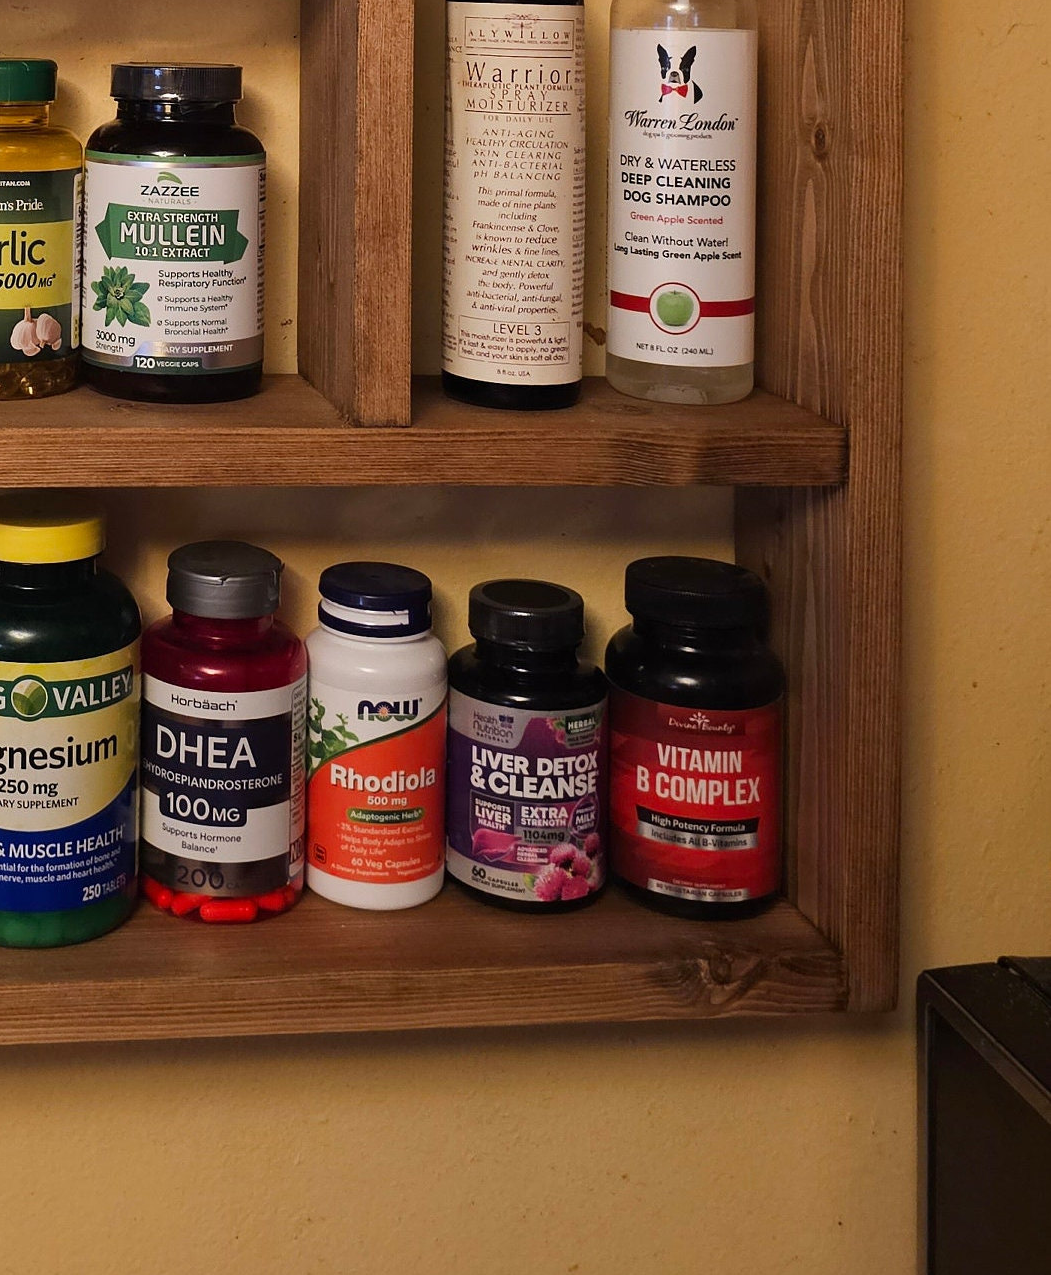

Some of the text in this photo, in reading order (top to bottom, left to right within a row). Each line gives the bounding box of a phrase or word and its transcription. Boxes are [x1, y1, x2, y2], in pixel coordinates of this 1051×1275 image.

[466, 61, 571, 85] Warrior
[490, 90, 548, 100] SPRAY
[466, 100, 568, 112] MOISTURIZER
[624, 109, 735, 131] Warren London
[620, 155, 736, 171] DRY & WATERLESS
[621, 172, 731, 189] DEEP CLEANING
[140, 185, 199, 196] ZAZZEE
[623, 190, 731, 207] DOG SHAMPOO
[16, 200, 43, 211] Pride
[128, 211, 218, 223] EXTRA STRENGTH
[631, 212, 723, 225] Green Apple Scented
[120, 223, 225, 246] MULLEIN
[162, 248, 210, 257] EXTRACT
[494, 323, 542, 335] LEVEL 3
[52, 672, 130, 710] VALLEY
[172, 694, 235, 710] Horbäach
[156, 724, 256, 770] DHEA
[472, 746, 598, 776] LIVER DETOX
[657, 743, 742, 773] VITAMIN
[331, 763, 435, 792] Rhodiola
[471, 766, 597, 799] & CLEANSE
[637, 765, 760, 805] B COMPLEX
[32, 781, 58, 797] mg
[167, 792, 240, 822] 100MG
[367, 796, 407, 806] 500 mg
[521, 806, 568, 818] EXTRA
[520, 818, 566, 827] STRENGTH
[651, 814, 745, 833] High Potency Formula
